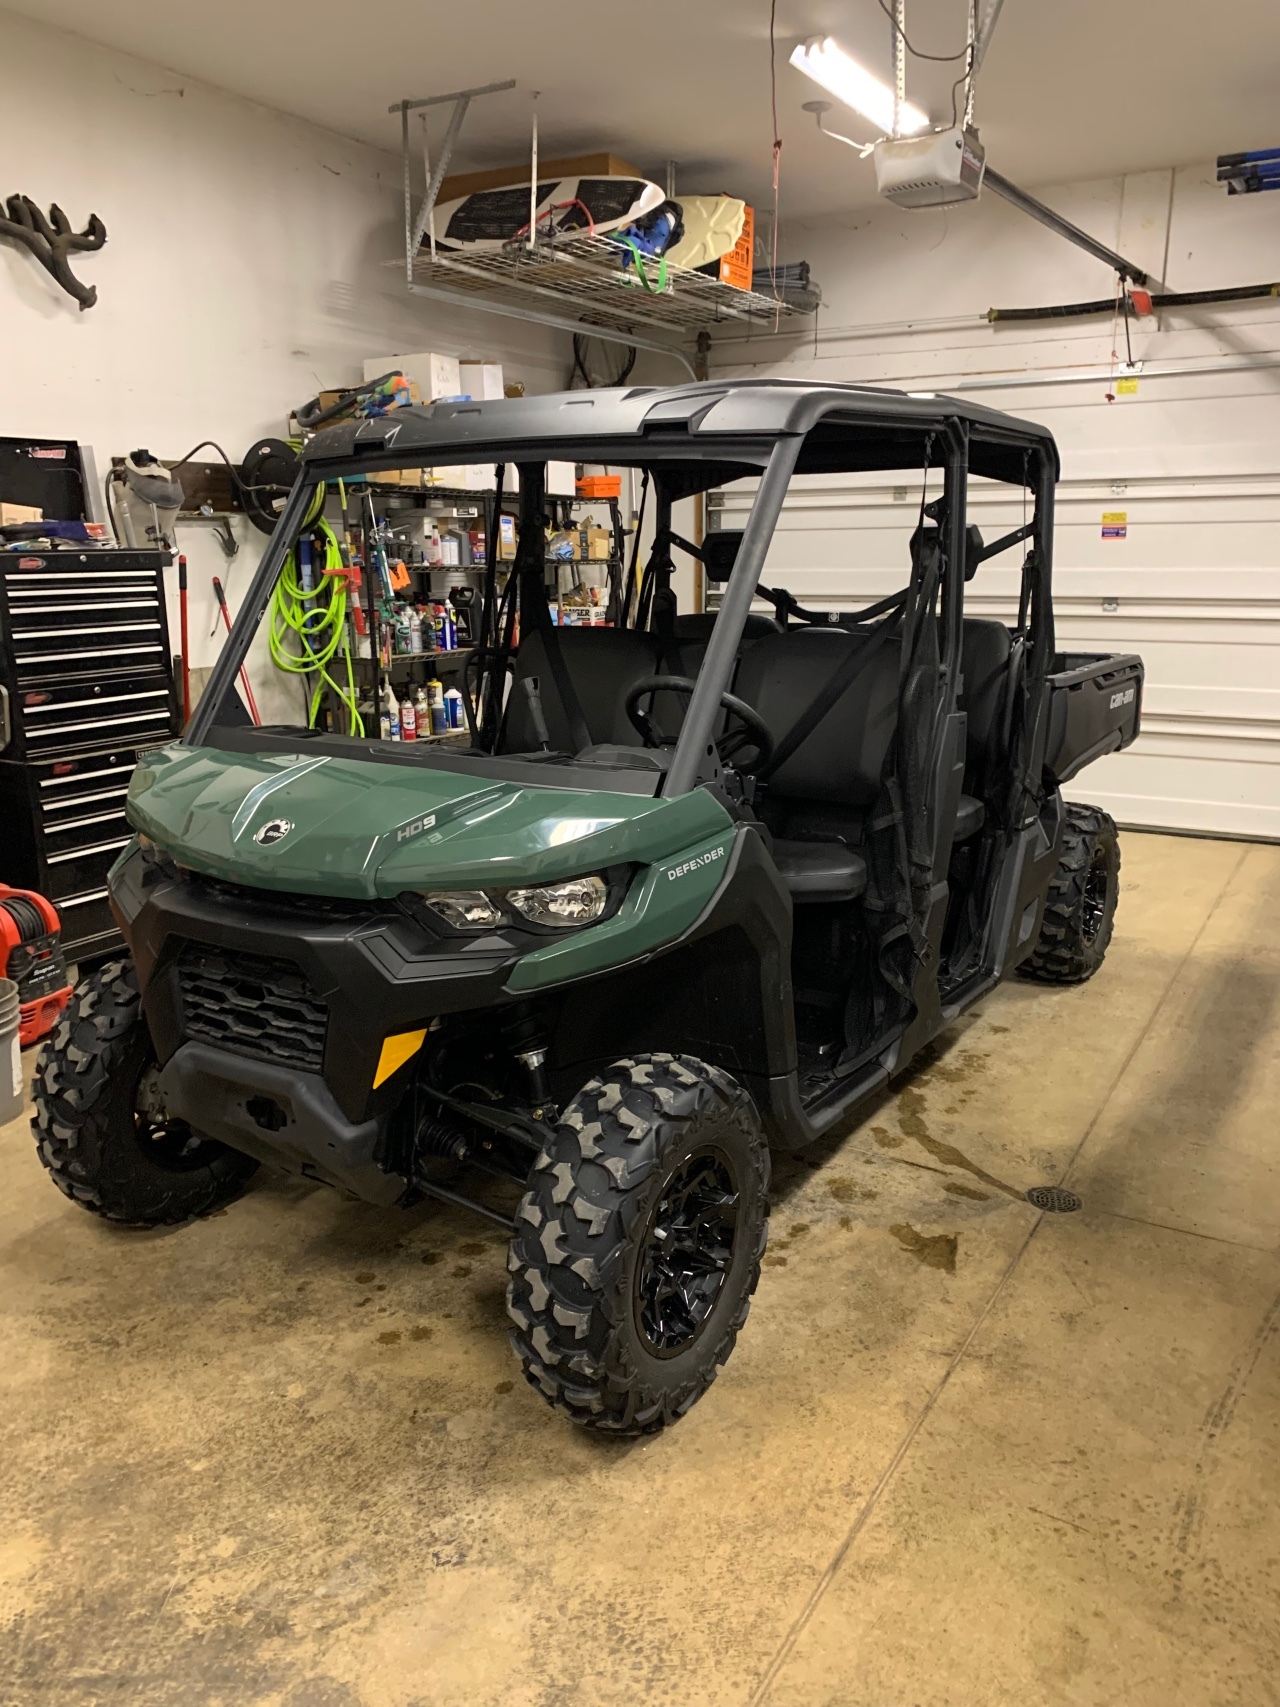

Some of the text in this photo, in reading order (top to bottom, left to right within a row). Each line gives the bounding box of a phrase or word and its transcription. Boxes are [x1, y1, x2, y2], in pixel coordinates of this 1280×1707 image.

[266, 830, 284, 838] BRP
[397, 814, 436, 842] HD9
[667, 846, 725, 881] DEFENDER
